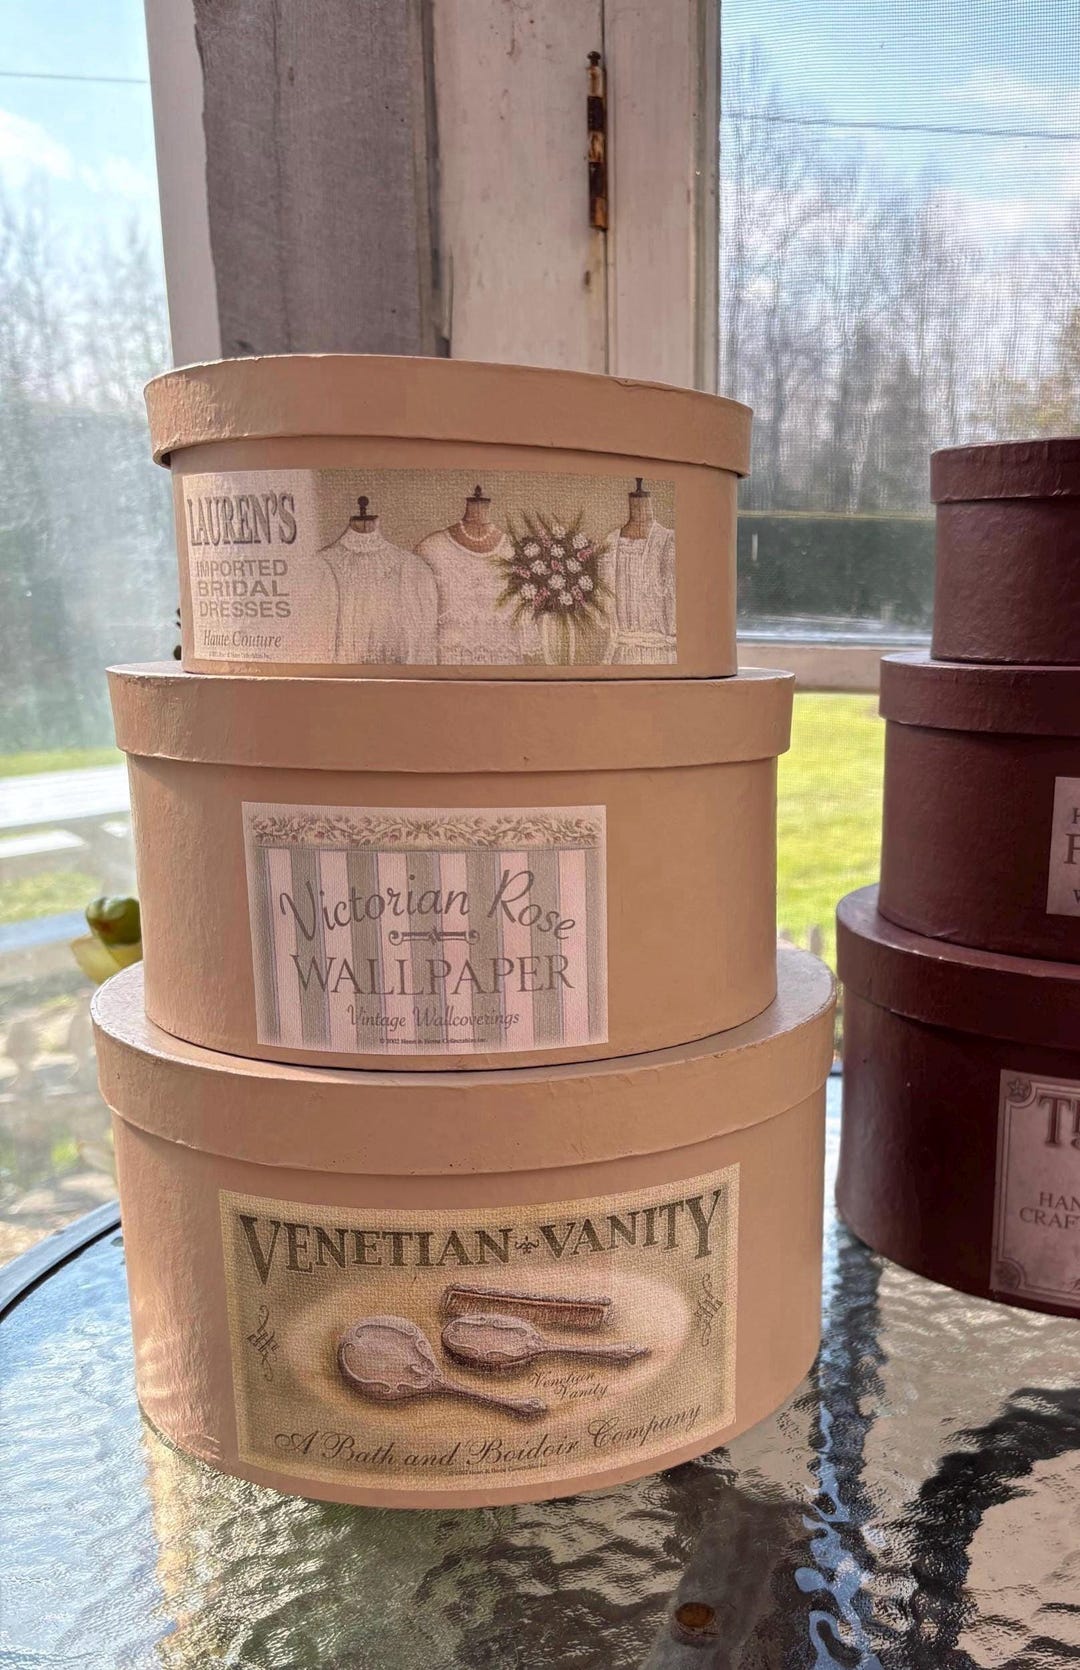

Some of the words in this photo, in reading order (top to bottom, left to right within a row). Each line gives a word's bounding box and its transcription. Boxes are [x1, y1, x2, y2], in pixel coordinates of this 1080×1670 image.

[187, 491, 297, 546] LAUREN'S
[196, 559, 289, 577] IMPORTED
[199, 579, 290, 597] BRIDAL
[199, 601, 292, 618] DRESSES
[203, 629, 231, 647] Haute
[232, 630, 282, 648] Couture
[279, 873, 470, 942] Victorian
[487, 869, 576, 940] Rose
[289, 954, 576, 996] WALLPAPER
[347, 1004, 406, 1032] Vintage
[412, 1005, 520, 1030] Wallcoverings
[240, 1214, 513, 1285] VENETIAN
[539, 1189, 722, 1260] VANITY
[530, 1371, 595, 1388] Venetian
[553, 1382, 609, 1401] Vanity
[274, 1430, 319, 1455] A
[322, 1431, 395, 1465] Bath
[403, 1442, 462, 1467] and
[588, 1405, 701, 1446] Company
